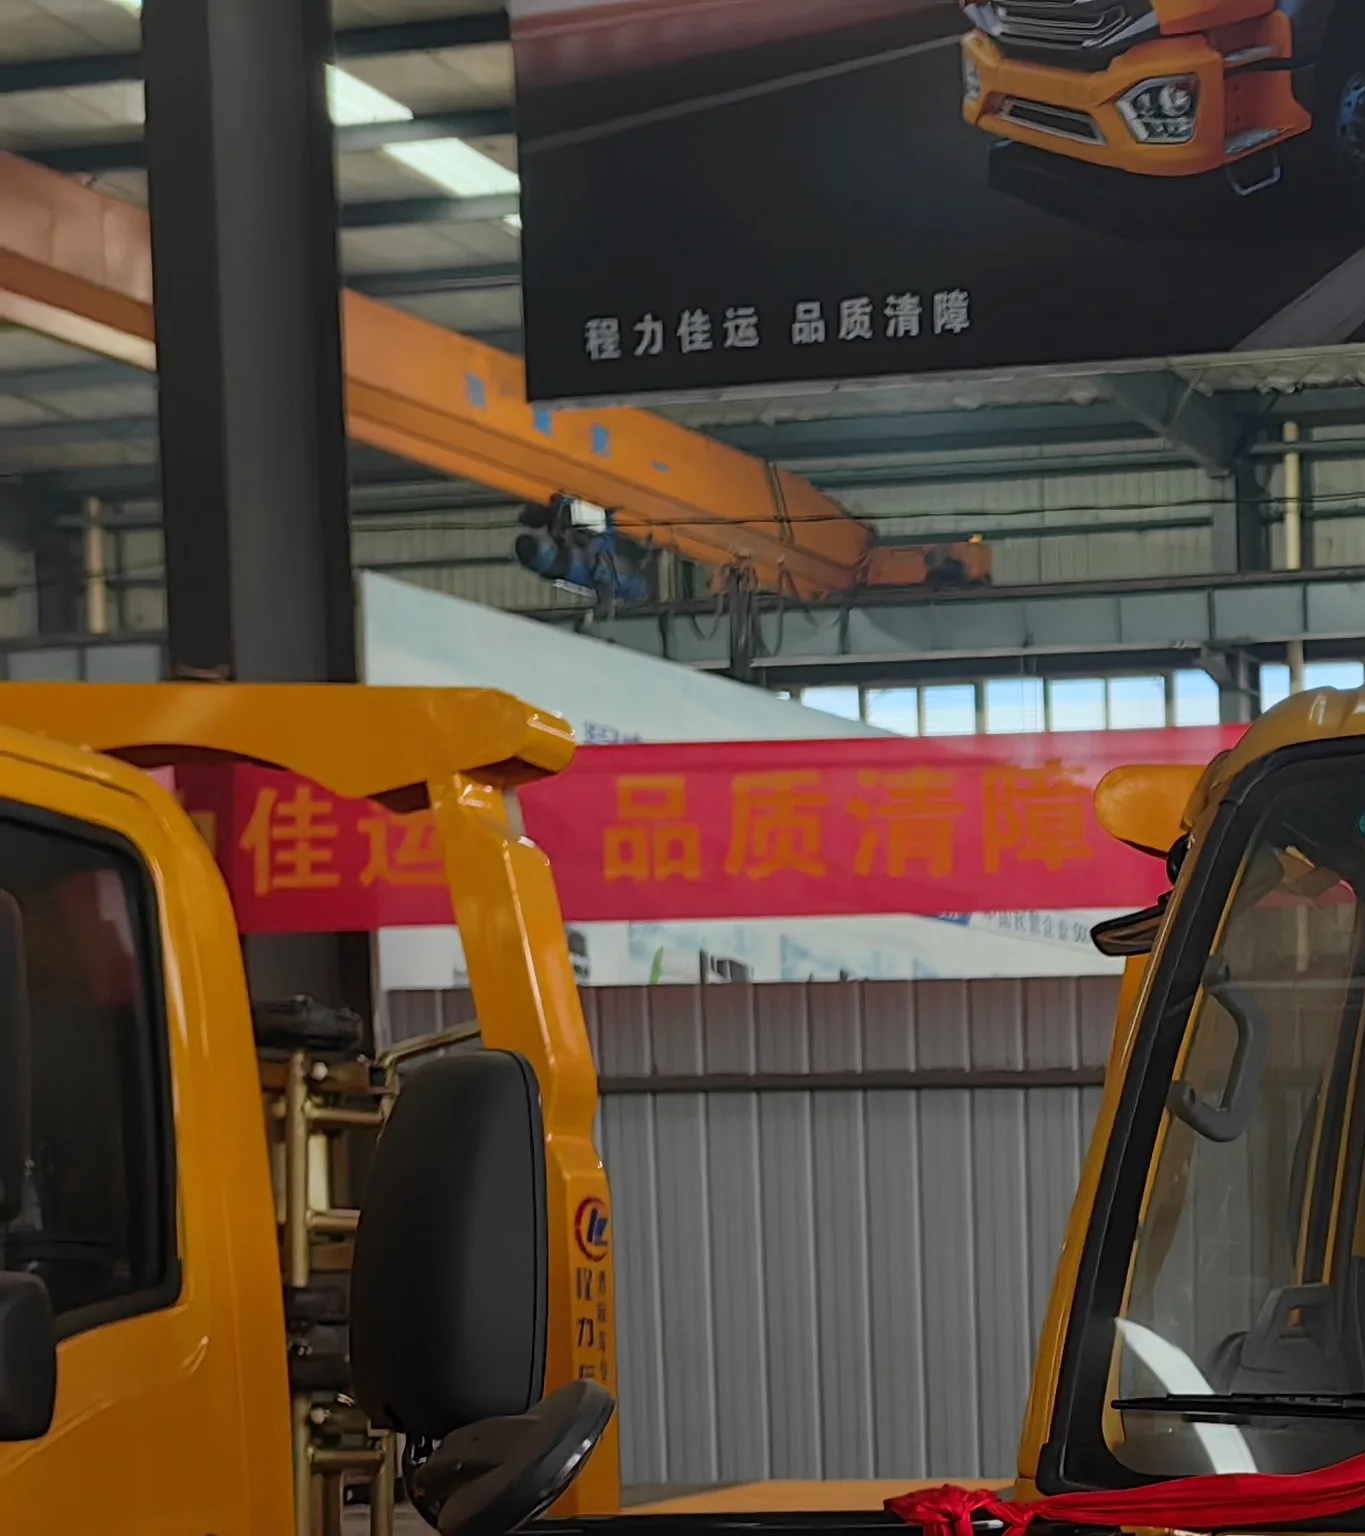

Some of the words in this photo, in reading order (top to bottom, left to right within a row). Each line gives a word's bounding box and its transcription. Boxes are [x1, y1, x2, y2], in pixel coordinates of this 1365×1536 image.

[585, 307, 761, 361] 程力佳运
[791, 288, 971, 345] 品质清障
[187, 782, 447, 898] 佳运
[603, 758, 1096, 884] 品质清障
